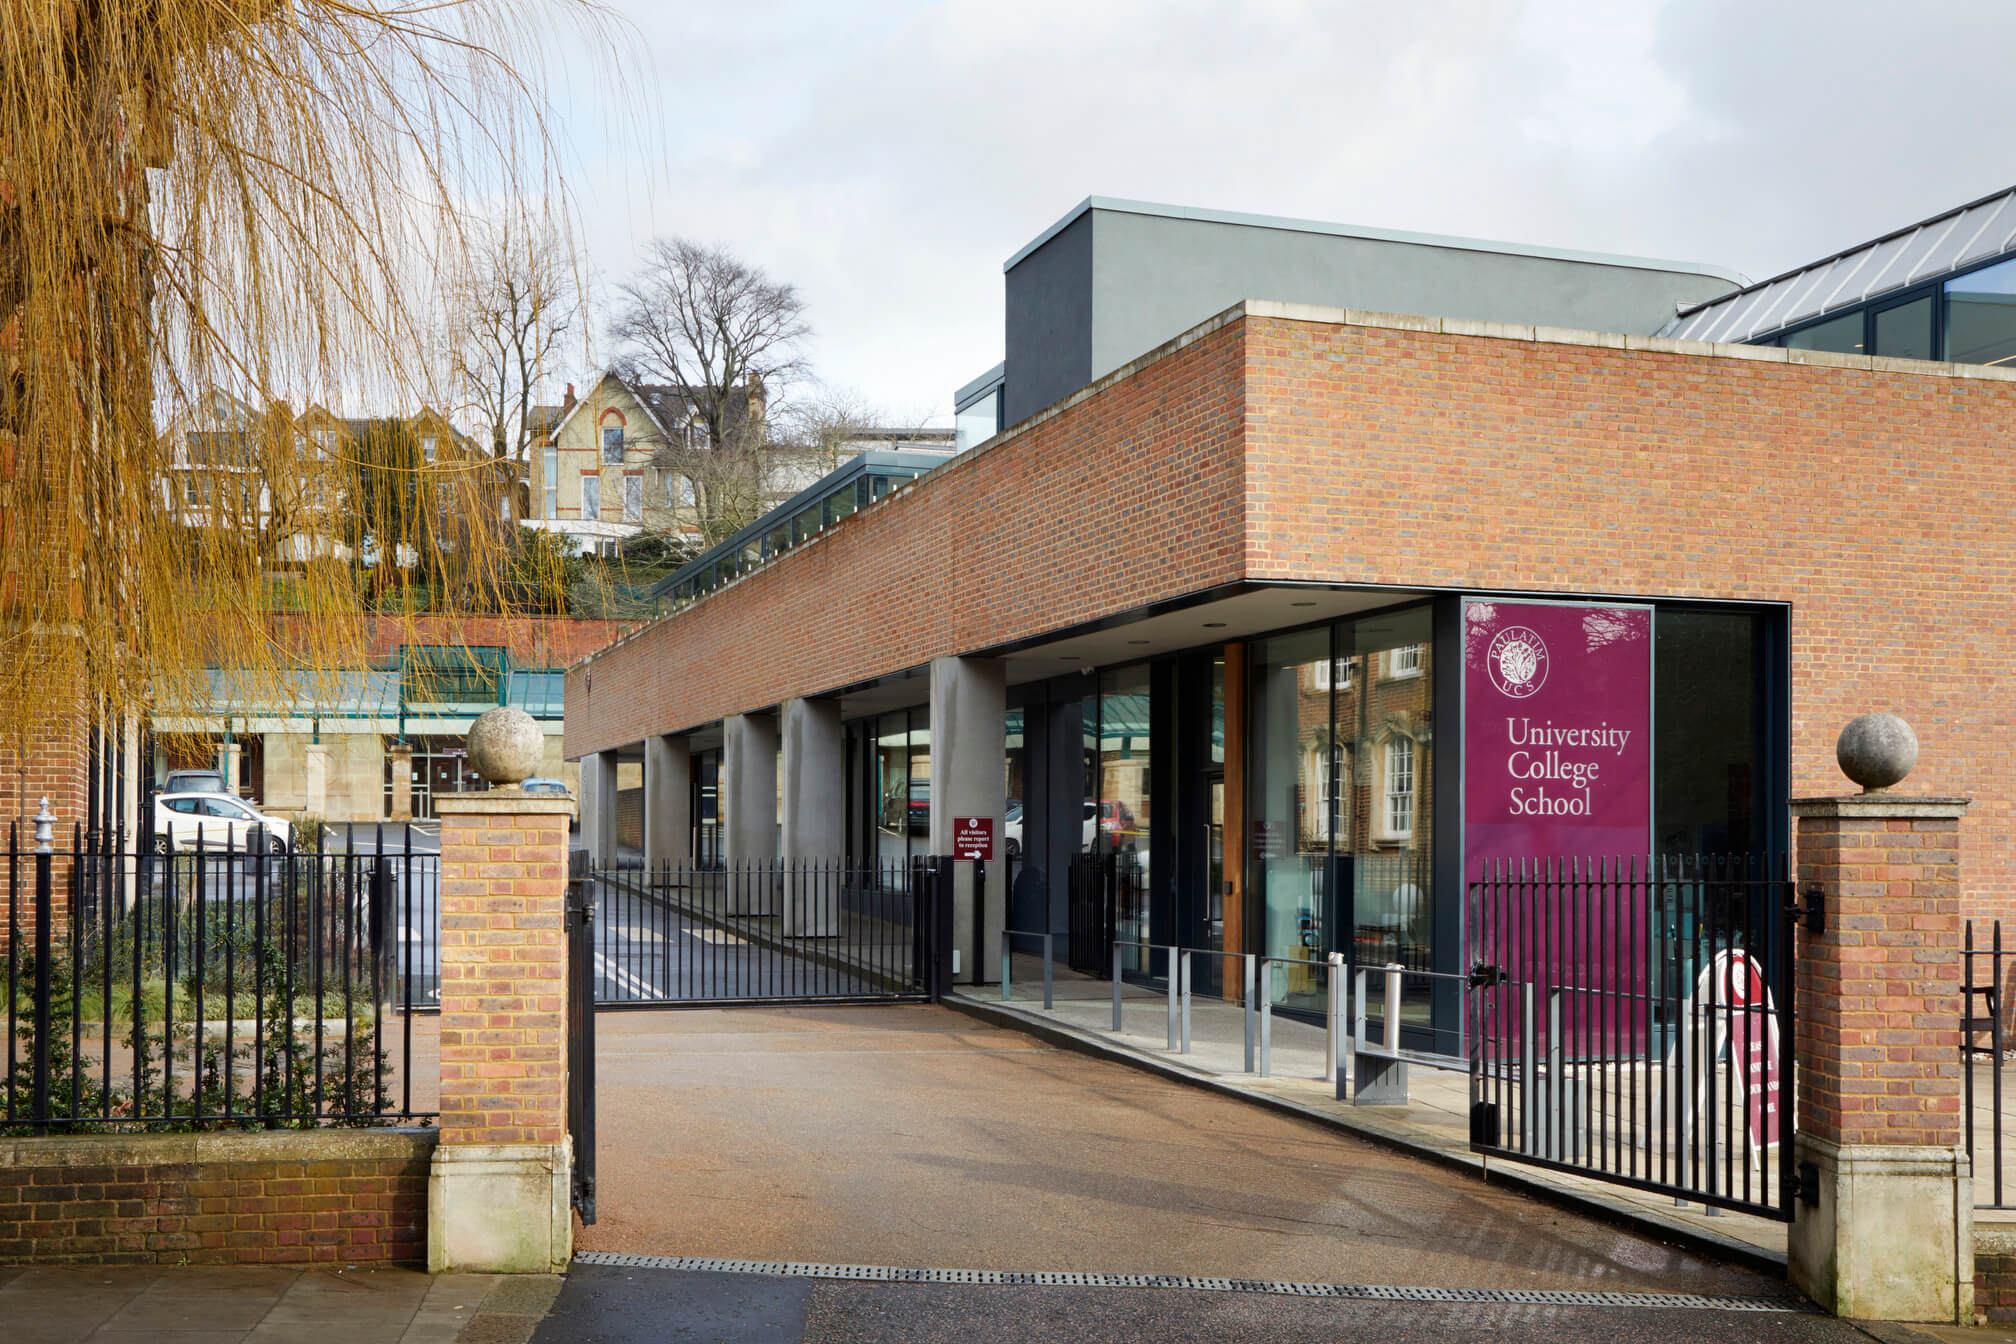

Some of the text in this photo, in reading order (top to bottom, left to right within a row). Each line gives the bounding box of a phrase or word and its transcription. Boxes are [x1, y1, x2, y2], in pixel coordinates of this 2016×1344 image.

[1491, 630, 1545, 660] PAULATIM
[1502, 680, 1534, 695] UCS
[1506, 717, 1632, 756] University
[1508, 750, 1600, 789] College
[1509, 786, 1592, 816] School
